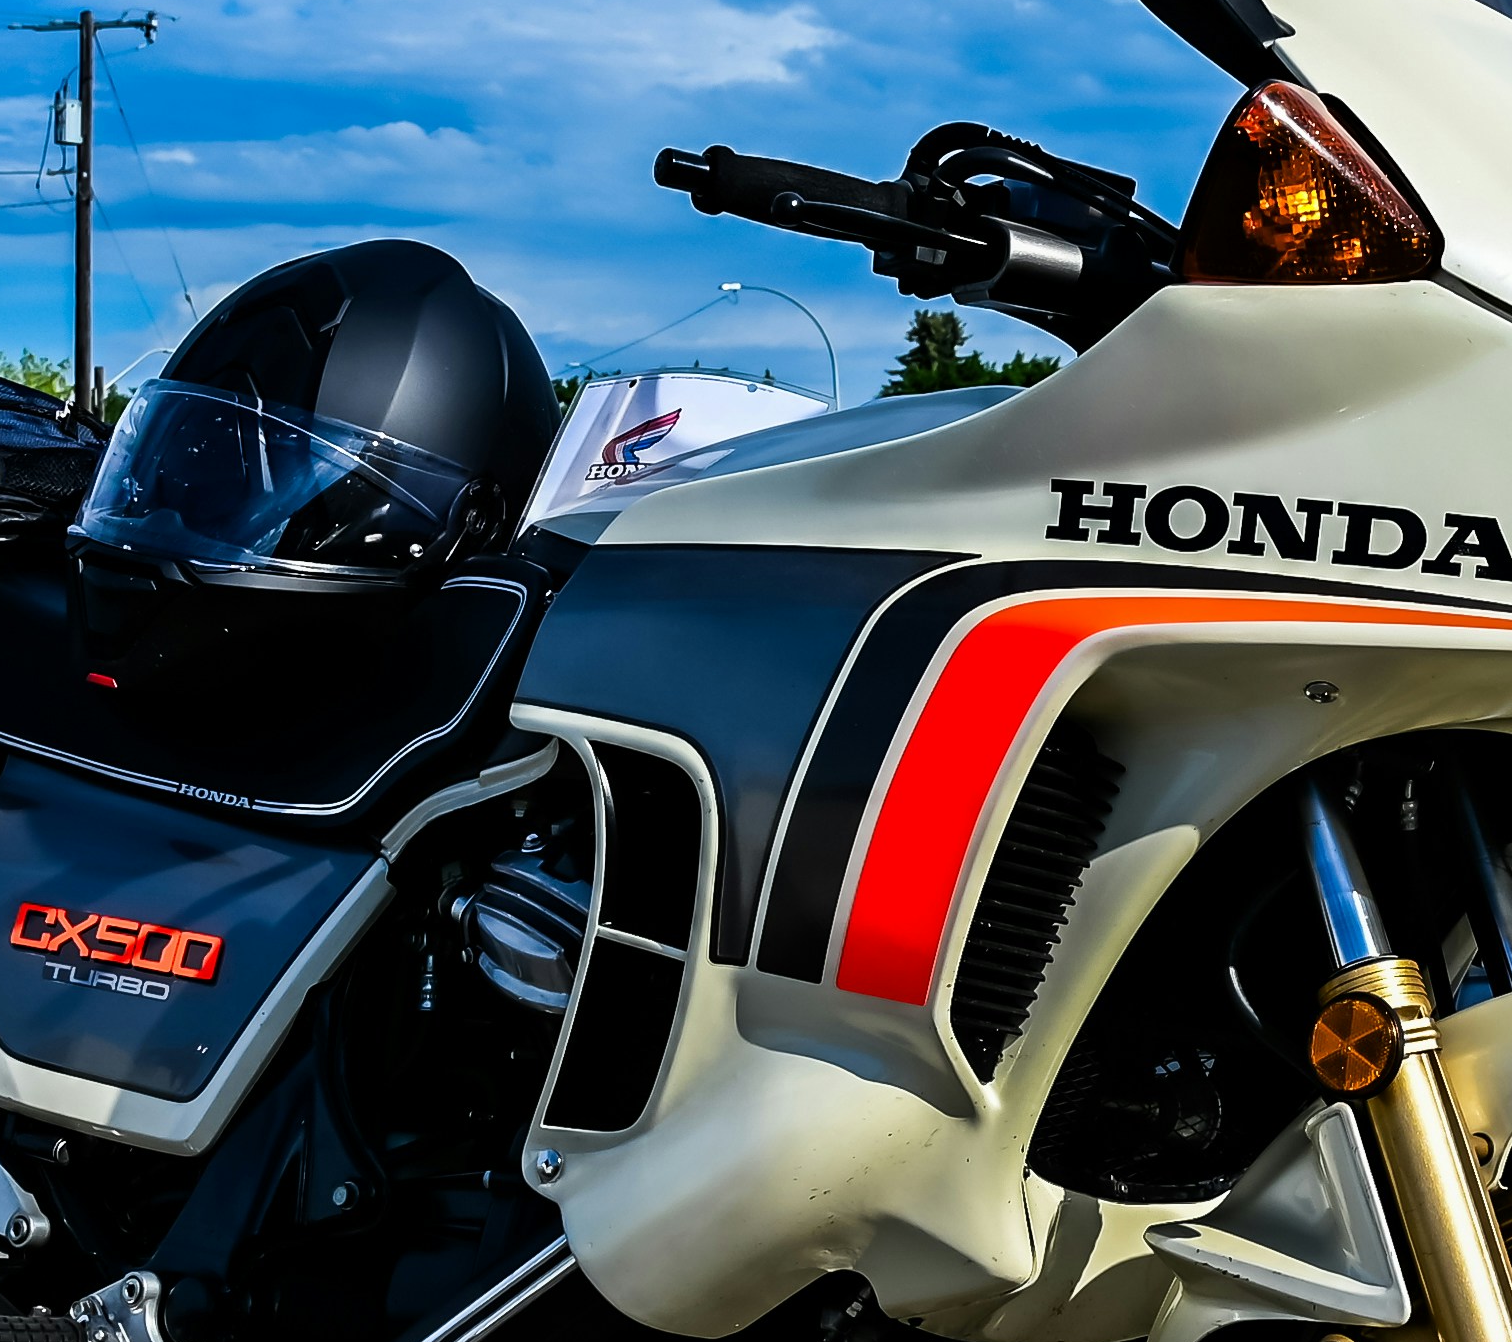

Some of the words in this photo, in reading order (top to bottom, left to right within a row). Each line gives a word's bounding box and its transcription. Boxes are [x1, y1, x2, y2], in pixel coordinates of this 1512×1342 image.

[178, 783, 251, 809] HONDA
[10, 902, 224, 982] CX500
[45, 961, 170, 1001] TURBO
